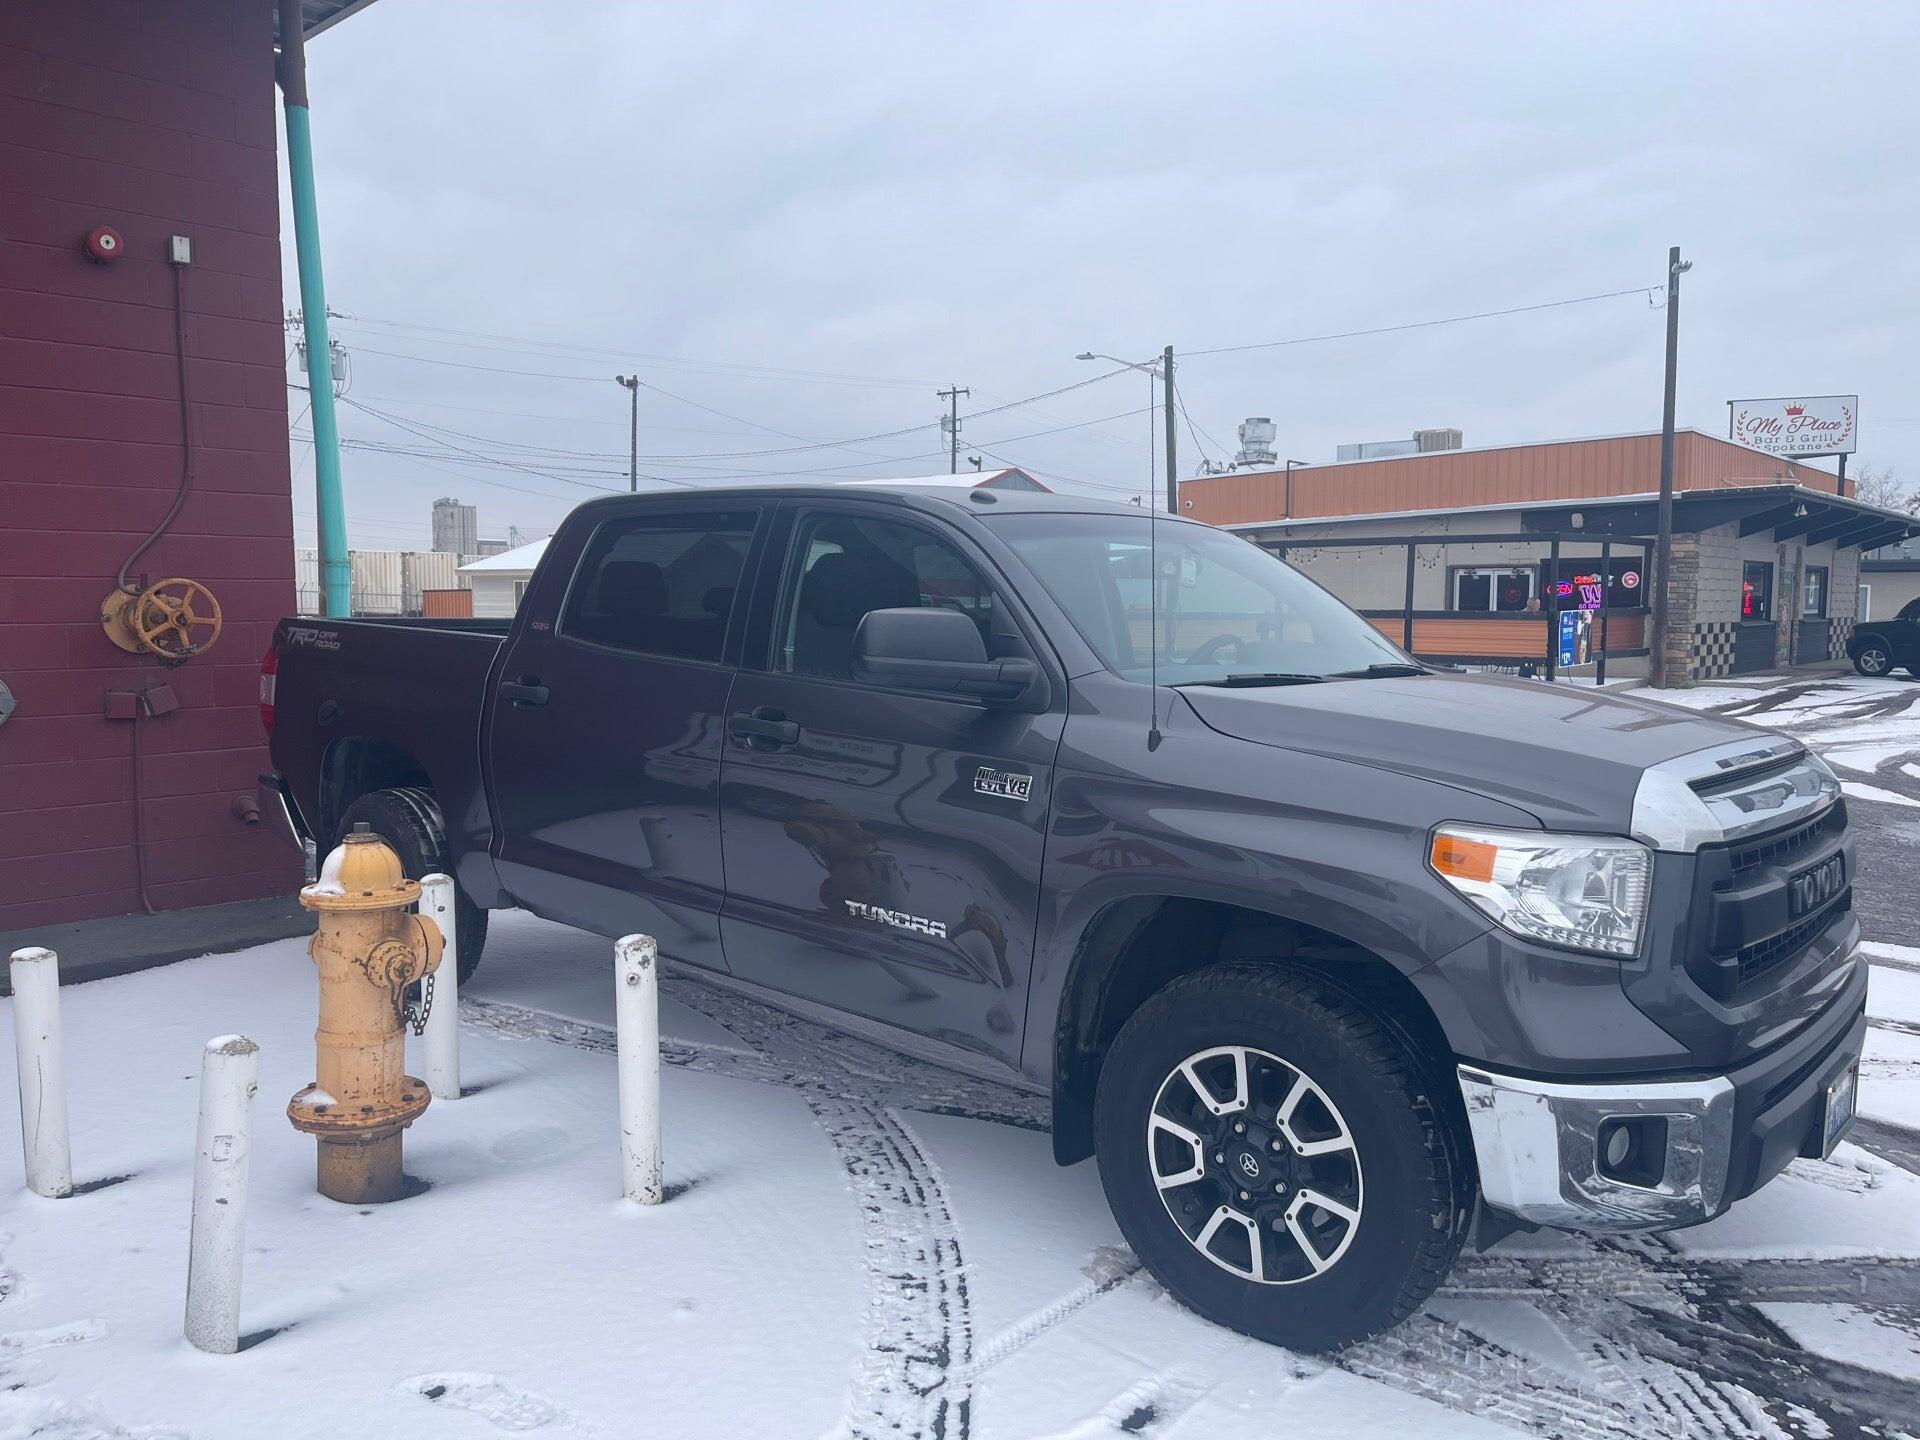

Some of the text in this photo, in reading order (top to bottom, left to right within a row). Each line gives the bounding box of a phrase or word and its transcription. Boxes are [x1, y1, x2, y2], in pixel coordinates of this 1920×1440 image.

[1746, 415, 1842, 436] My Place
[1754, 433, 1834, 445] Bar & Grill
[1764, 443, 1822, 453] Spokane
[287, 626, 319, 646] TRD
[1005, 777, 1028, 797] V8
[1792, 856, 1843, 915] TOYOTA
[844, 899, 947, 939] TUNDRA
